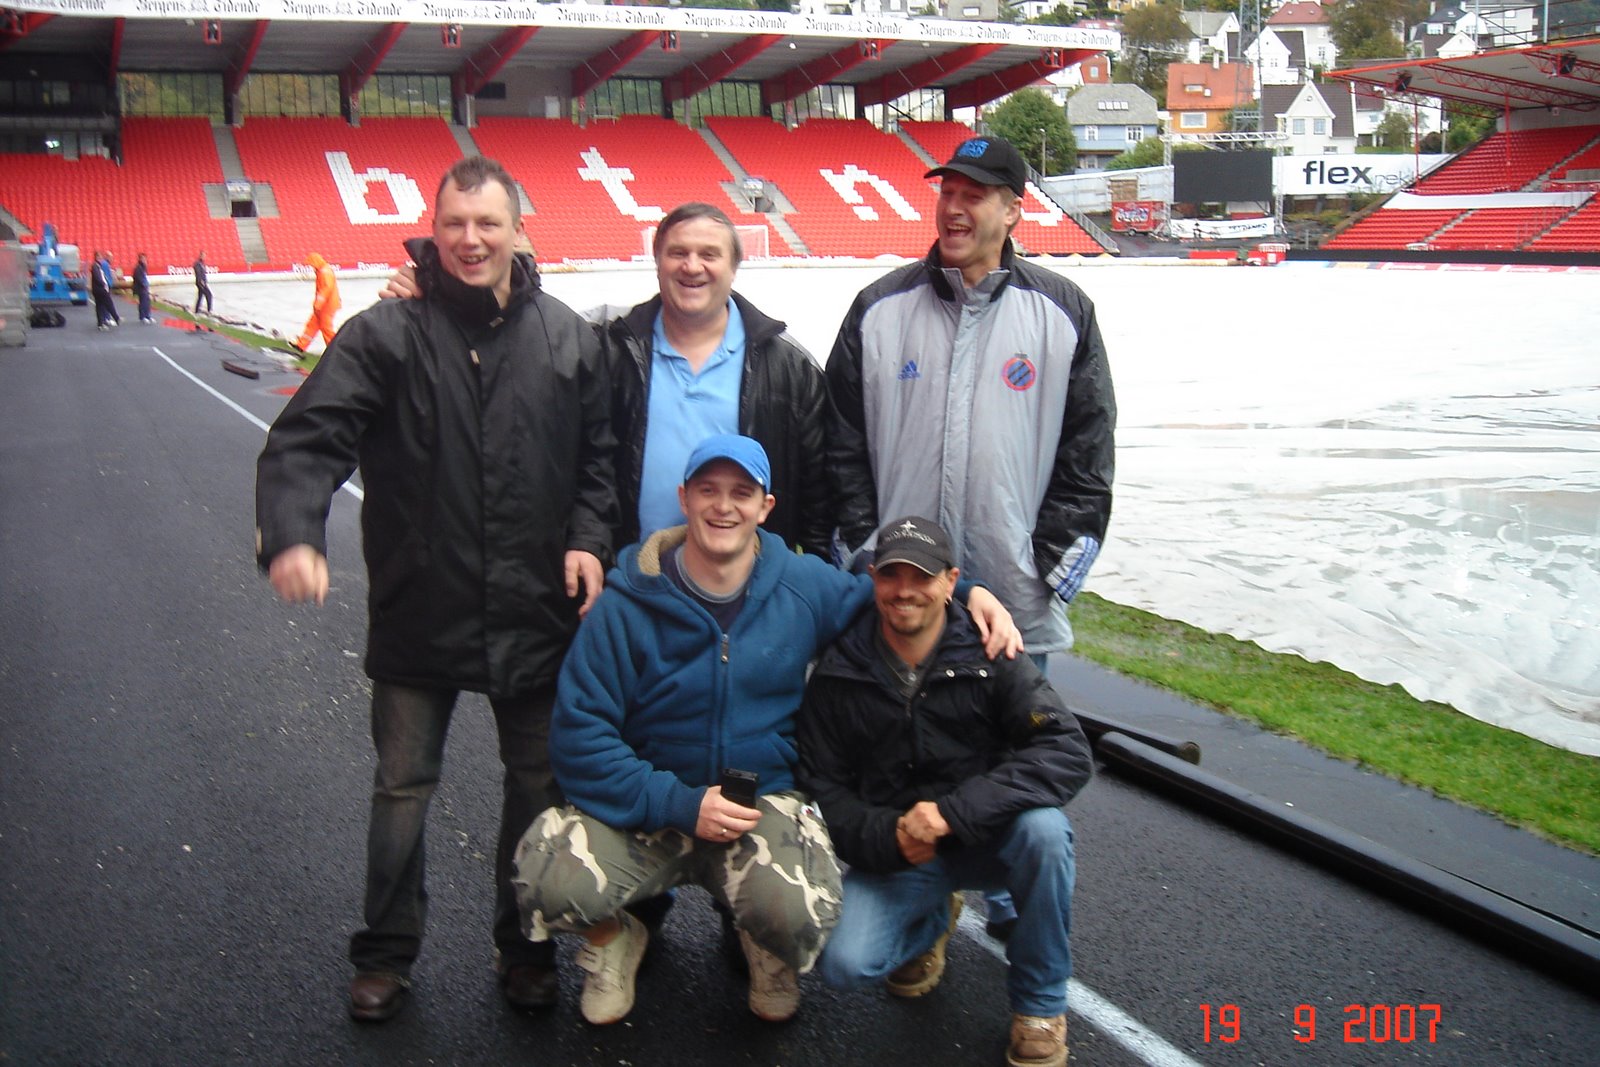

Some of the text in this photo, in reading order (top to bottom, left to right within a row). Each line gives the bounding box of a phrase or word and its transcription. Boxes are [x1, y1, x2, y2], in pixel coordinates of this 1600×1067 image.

[214, 0, 260, 13] Tidende
[357, 0, 402, 15] Tidende
[494, 5, 537, 20] Tidende
[625, 10, 666, 24] Tidende
[748, 14, 788, 29] Tidende
[865, 20, 903, 35] Tidende
